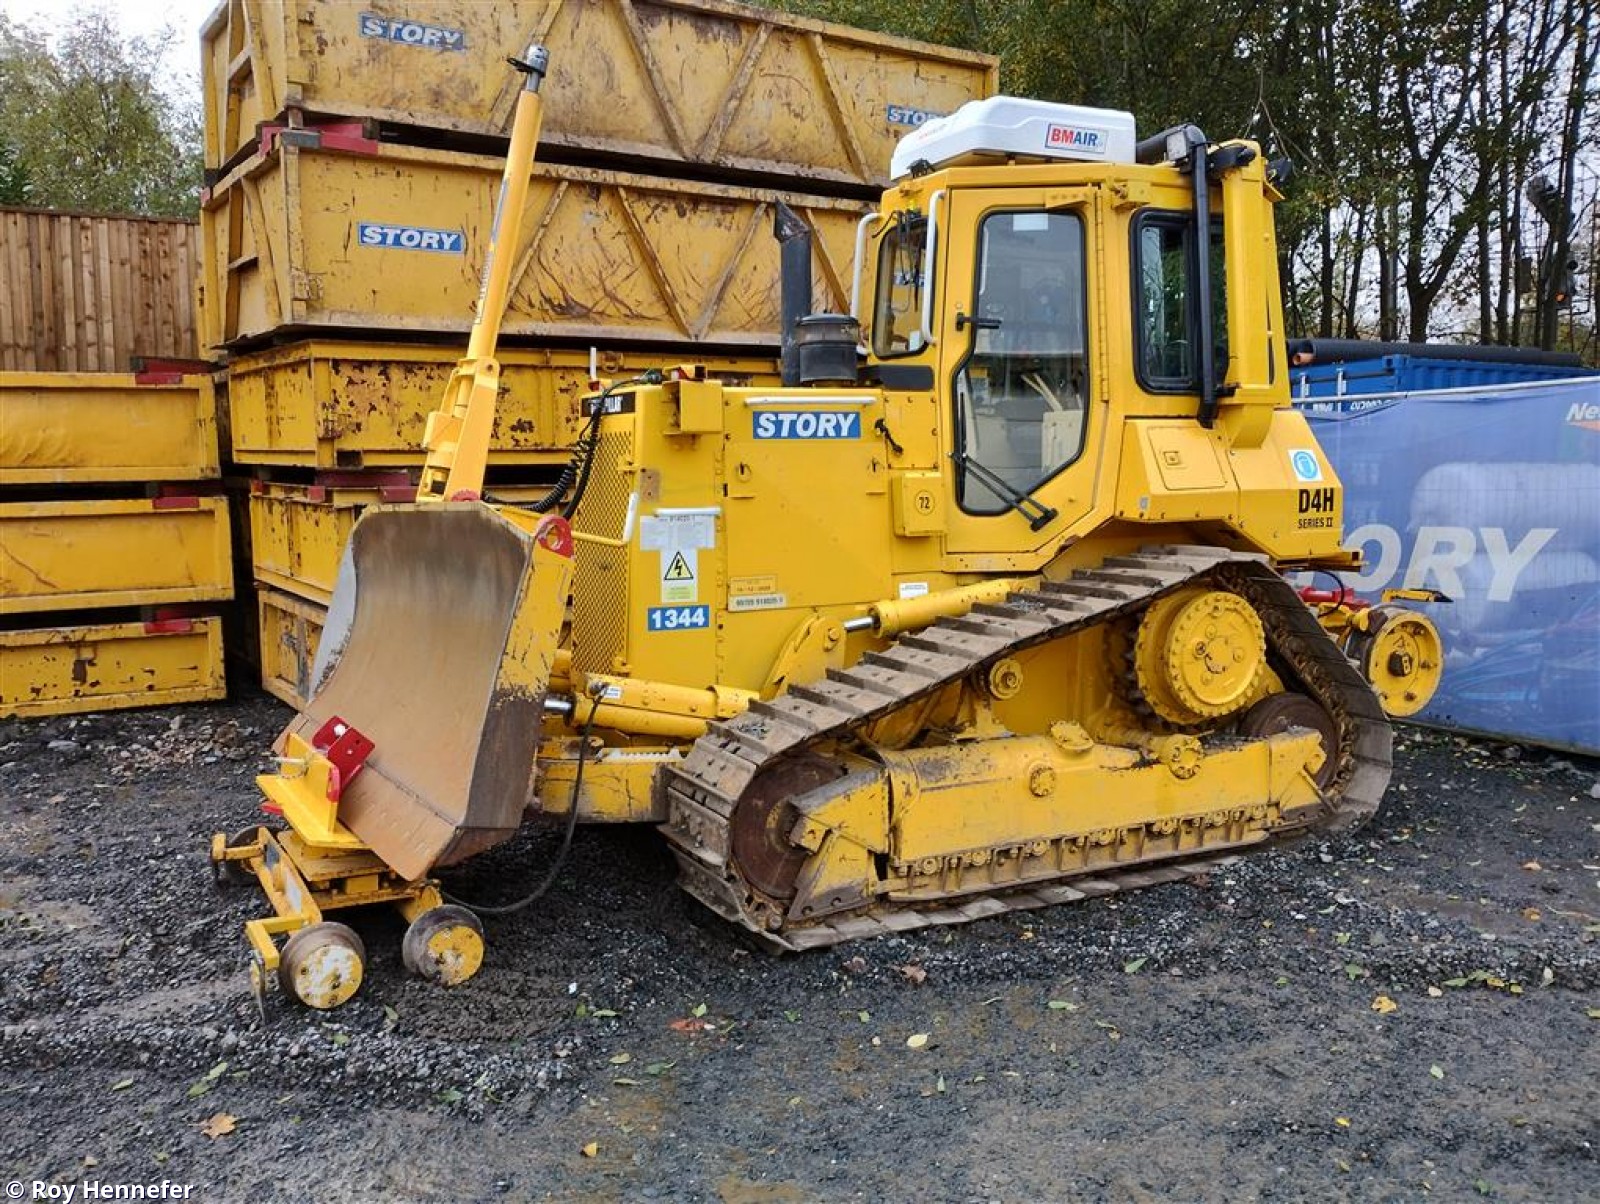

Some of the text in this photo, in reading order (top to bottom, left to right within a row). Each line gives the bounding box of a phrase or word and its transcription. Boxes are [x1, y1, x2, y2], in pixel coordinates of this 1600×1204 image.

[363, 19, 461, 47] STORY
[1050, 127, 1098, 147] BMAIR
[363, 225, 458, 249] STORY
[1565, 402, 1600, 421] Ne
[757, 413, 856, 437] STORY
[919, 497, 930, 509] 72
[1299, 488, 1334, 513] D4H
[1298, 517, 1333, 529] SERIES II
[1336, 524, 1559, 602] ORY
[652, 607, 705, 629] 1344
